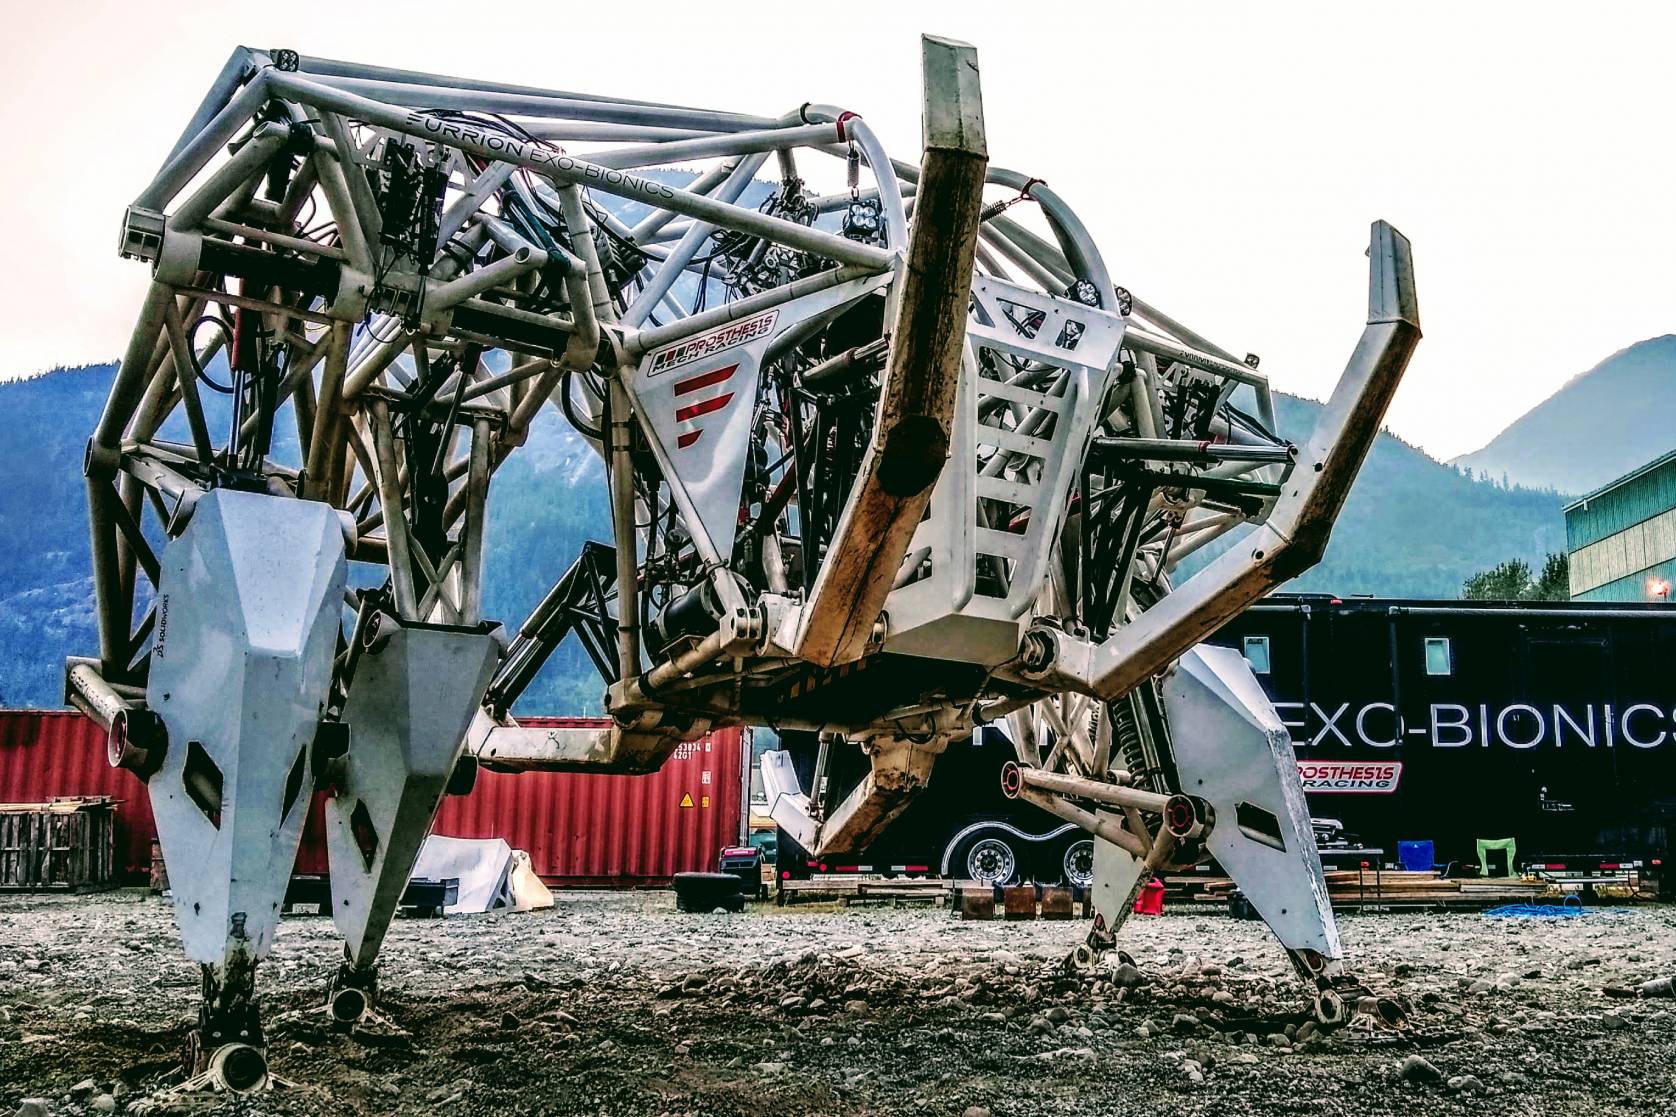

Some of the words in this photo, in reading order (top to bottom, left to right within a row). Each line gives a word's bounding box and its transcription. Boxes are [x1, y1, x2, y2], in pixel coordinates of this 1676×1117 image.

[406, 112, 524, 158] FURRION
[529, 149, 675, 200] EXO-BIONICS
[652, 351, 700, 373] MECH
[704, 326, 770, 355] RACING
[685, 315, 774, 354] PROSTHESIS
[159, 593, 169, 642] SOLIDWORKS
[1271, 702, 1676, 748] EXO-BIONIC
[1297, 766, 1394, 780] OSTHESIS
[1302, 780, 1391, 788] RACING
